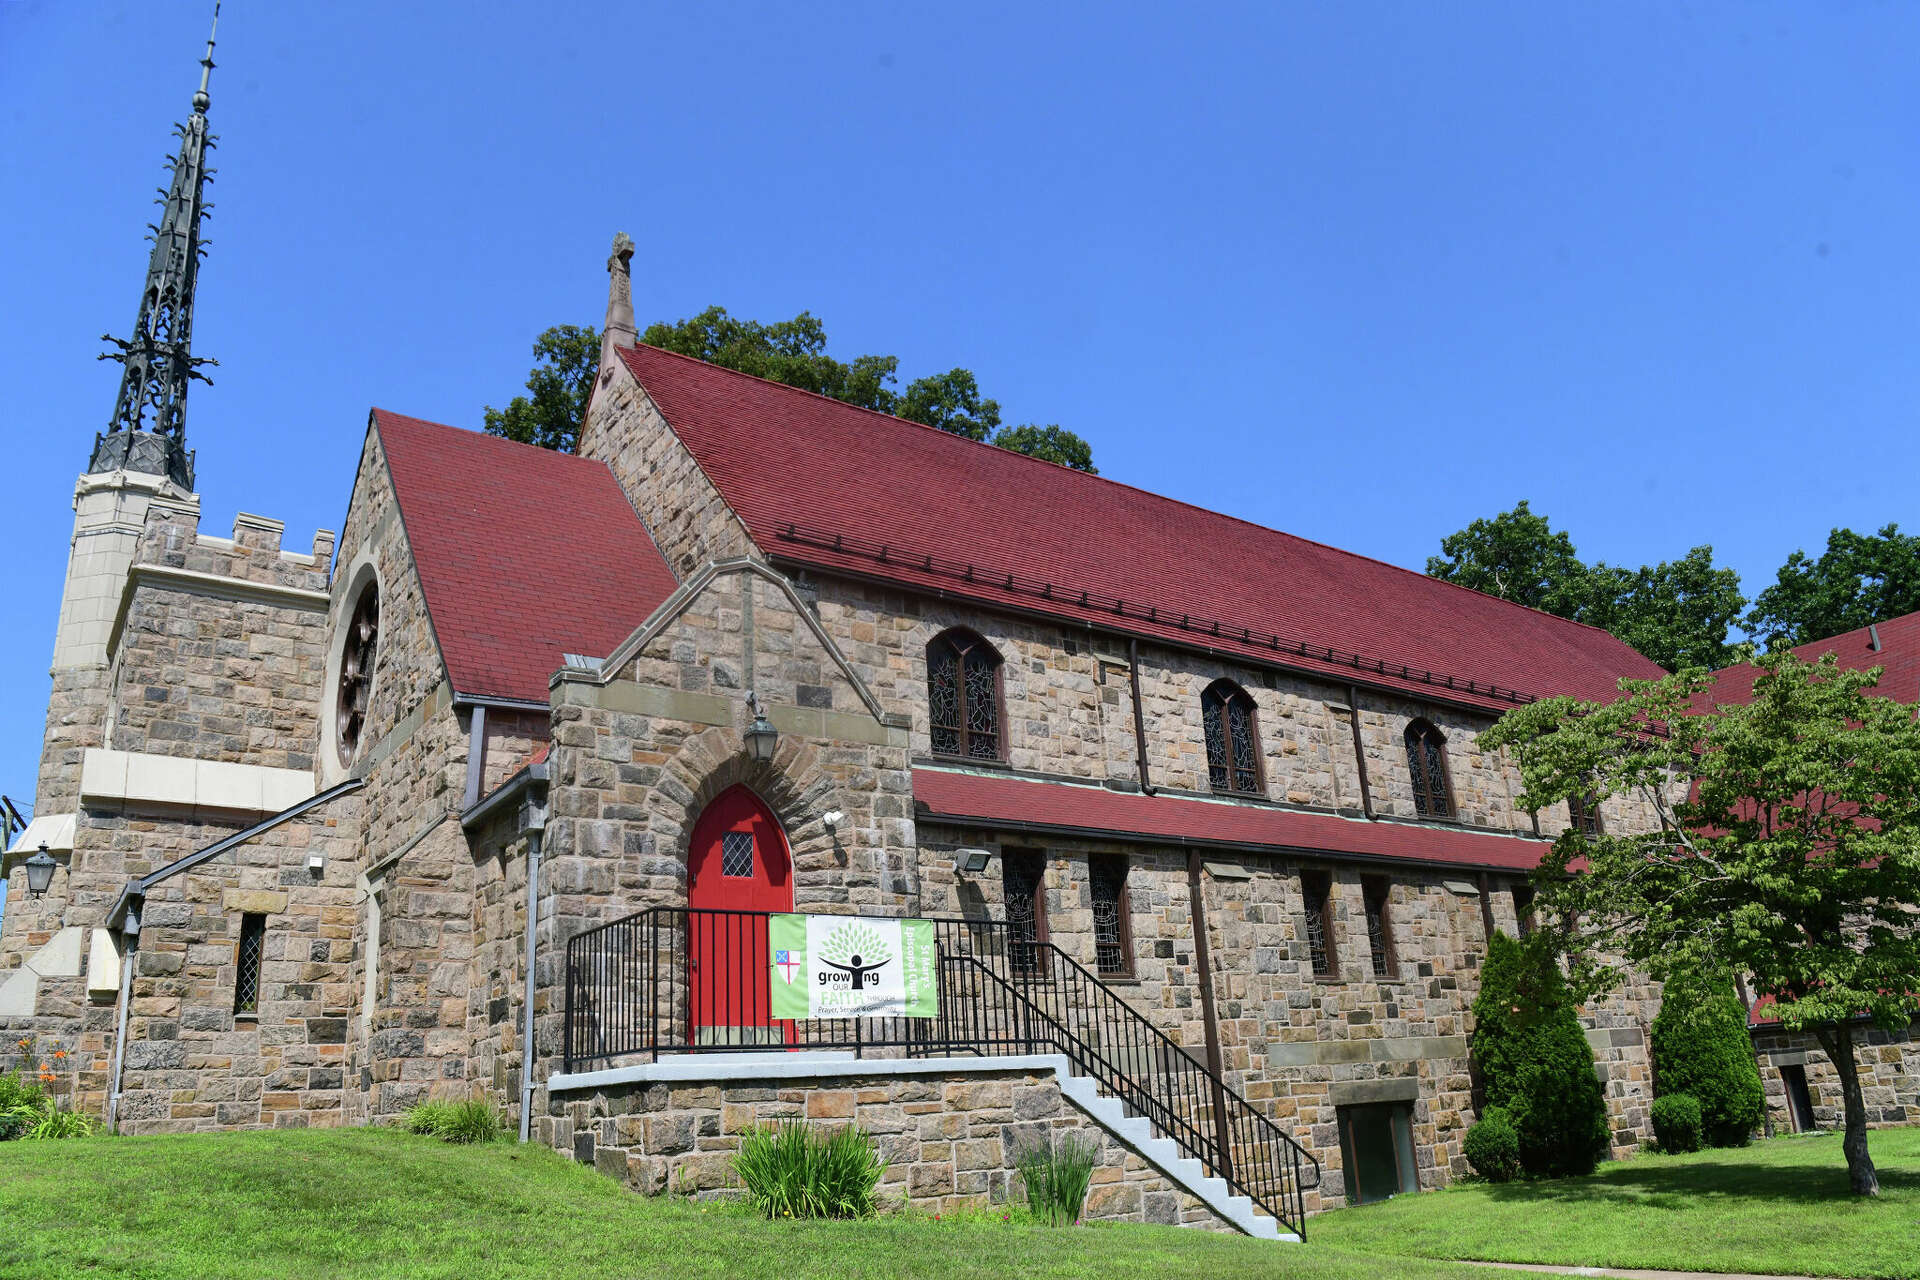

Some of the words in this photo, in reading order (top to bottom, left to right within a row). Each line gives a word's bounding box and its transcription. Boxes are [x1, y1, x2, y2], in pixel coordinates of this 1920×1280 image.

[904, 926, 917, 972] Episcopal
[821, 992, 864, 1006] FAITH
[832, 983, 849, 991] OUR
[908, 973, 920, 1008] Church
